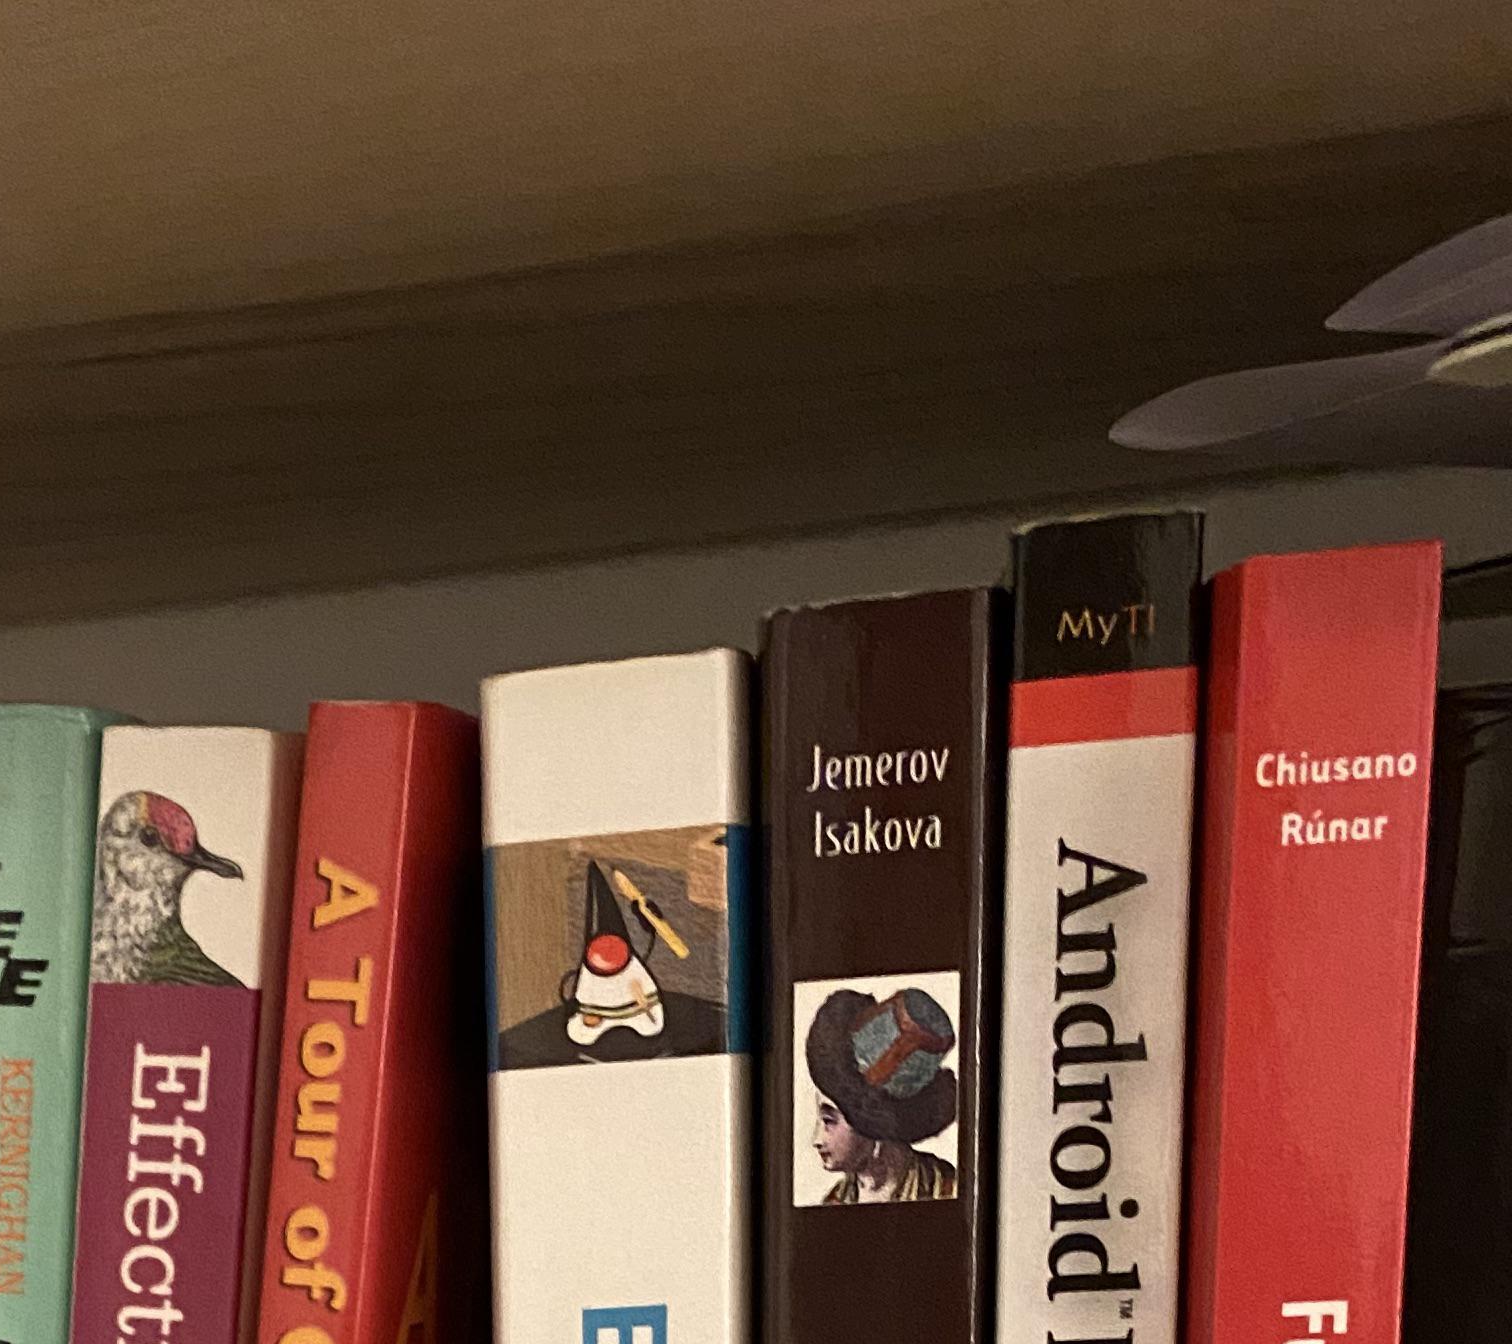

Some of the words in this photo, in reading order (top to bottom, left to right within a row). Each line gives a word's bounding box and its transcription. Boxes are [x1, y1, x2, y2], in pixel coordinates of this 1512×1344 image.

[807, 742, 949, 794] Jemerov
[1255, 751, 1417, 788] Chiusano
[814, 806, 943, 858] Isakova
[1281, 809, 1388, 846] Rúnar
[312, 857, 381, 929] A
[293, 956, 374, 1182] Tour
[283, 1205, 348, 1310] of
